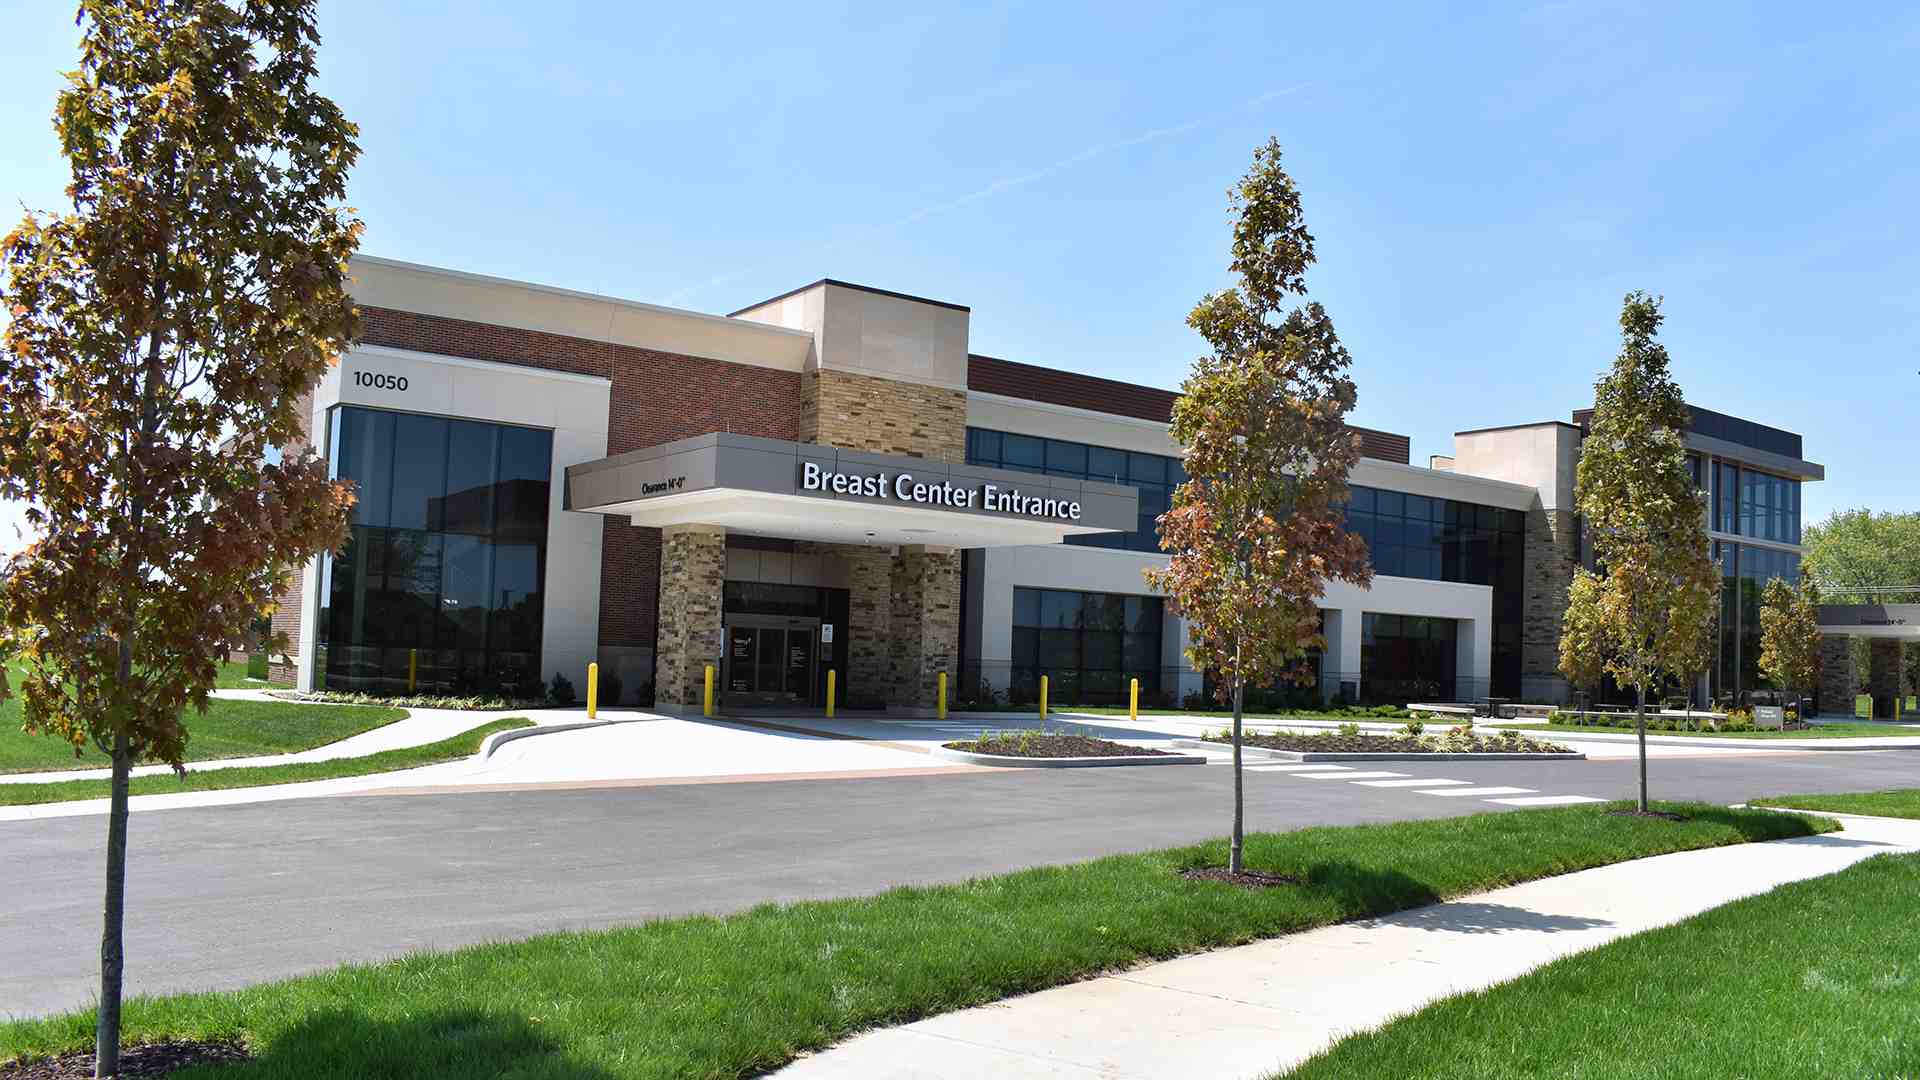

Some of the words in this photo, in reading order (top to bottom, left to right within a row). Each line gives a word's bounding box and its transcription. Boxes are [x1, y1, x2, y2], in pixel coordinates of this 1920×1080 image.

[353, 371, 409, 391] 10050
[803, 461, 888, 498] Breast
[895, 473, 977, 508] Center
[984, 484, 1081, 519] Entrance
